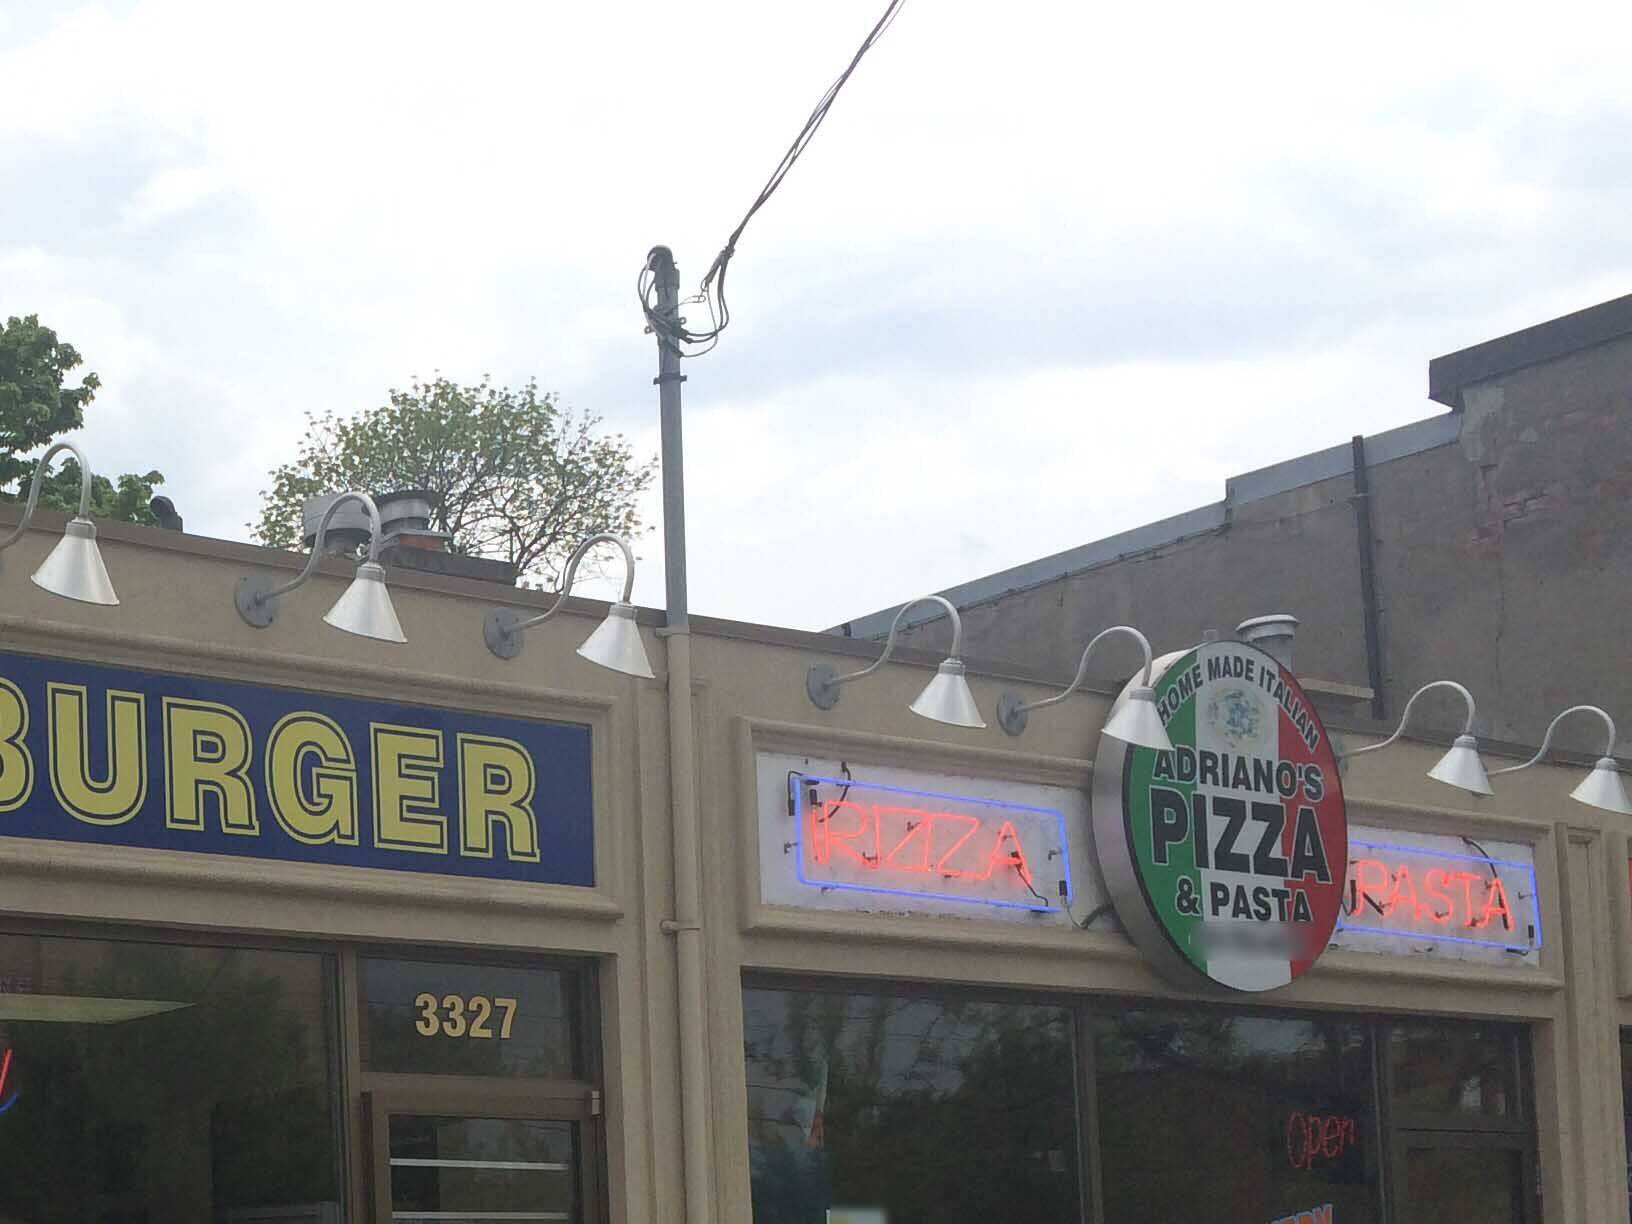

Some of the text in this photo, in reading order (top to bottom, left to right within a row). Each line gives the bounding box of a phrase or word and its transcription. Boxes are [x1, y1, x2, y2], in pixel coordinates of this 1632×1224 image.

[1156, 655, 1319, 753] HOME MADE ITALIAN
[1153, 745, 1324, 802] ADRIANO'S
[810, 799, 1032, 886] PIZZA
[1150, 785, 1332, 884] PIZZA
[1176, 876, 1313, 922] & PASTA
[1352, 858, 1514, 931] PASTA
[414, 991, 518, 1039] 3327
[1287, 1111, 1357, 1170] Open
